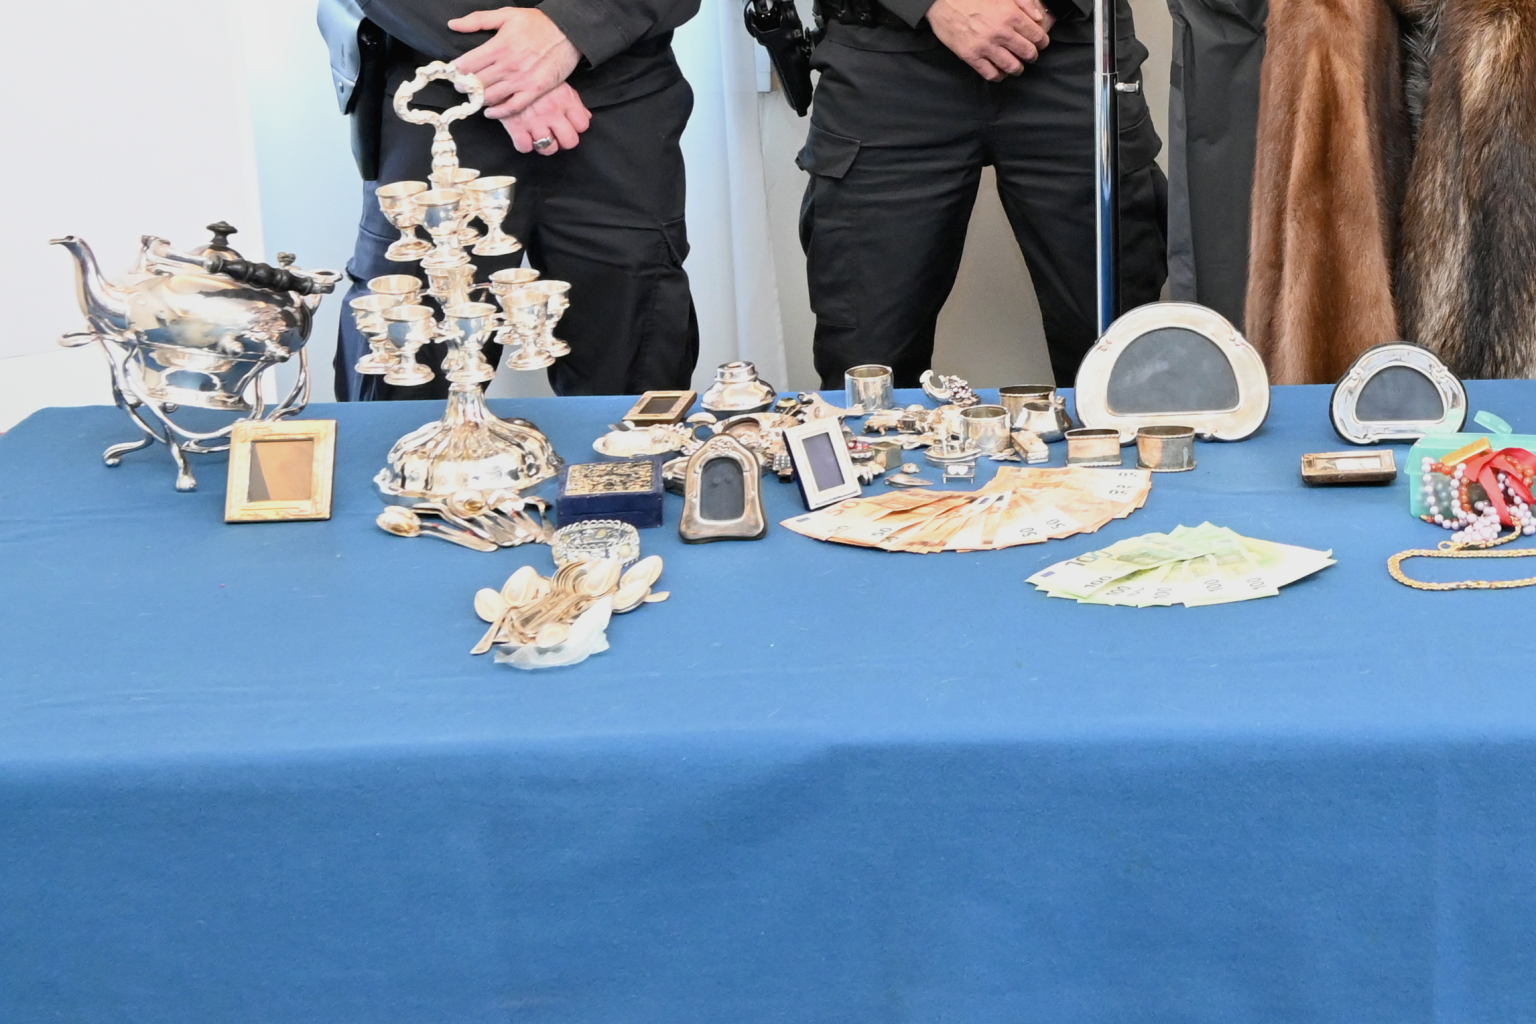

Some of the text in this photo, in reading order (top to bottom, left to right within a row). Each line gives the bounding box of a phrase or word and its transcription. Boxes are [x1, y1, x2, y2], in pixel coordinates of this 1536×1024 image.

[823, 500, 861, 517] 50
[1045, 518, 1066, 530] 50
[871, 527, 893, 538] 50
[1019, 527, 1038, 538] 50
[1065, 550, 1114, 567] 100
[1084, 575, 1113, 588] 100
[1203, 579, 1224, 592] 100
[1246, 577, 1267, 590] 100
[1153, 587, 1173, 599] 100
